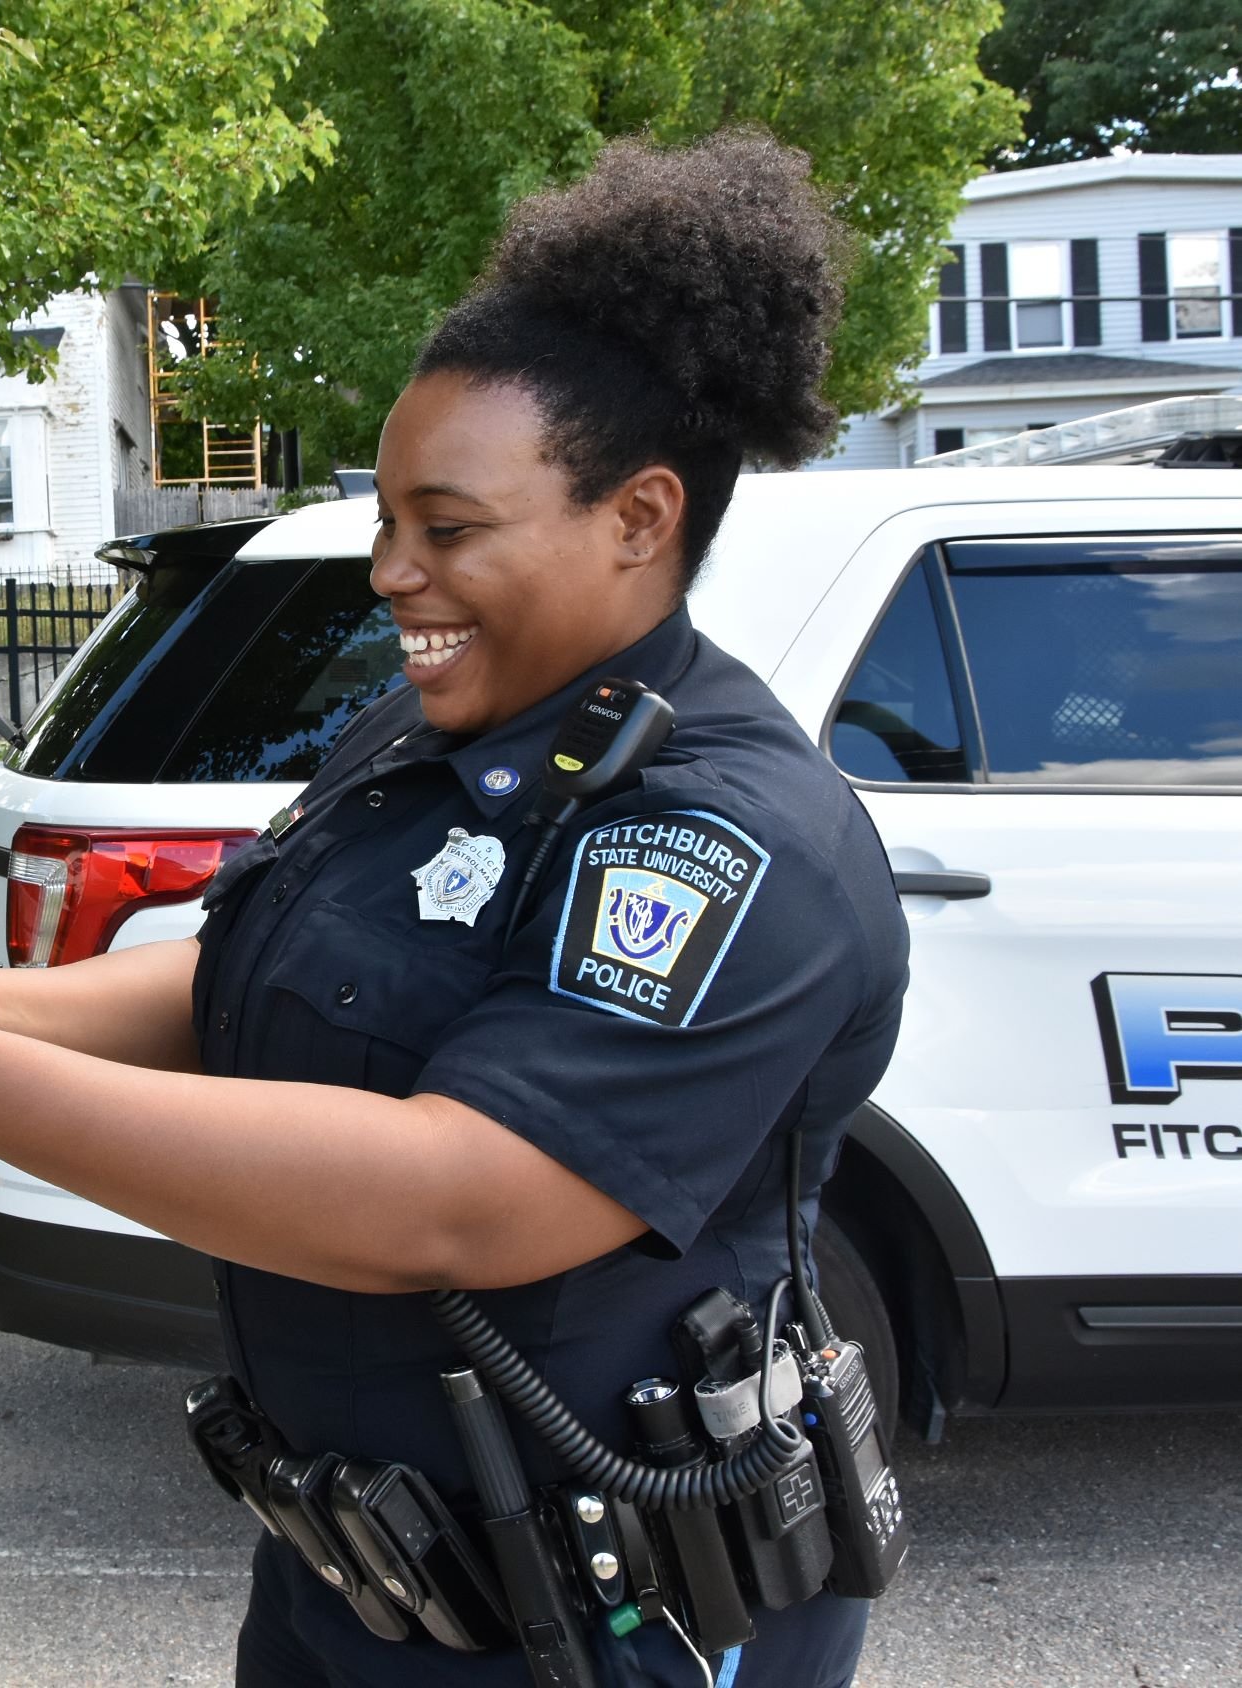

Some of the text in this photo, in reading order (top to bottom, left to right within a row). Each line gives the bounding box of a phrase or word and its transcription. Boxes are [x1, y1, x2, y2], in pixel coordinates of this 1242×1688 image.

[588, 704, 623, 721] KENWOOD
[450, 847, 495, 888] PATROLMAN
[461, 841, 500, 875] POLICE
[595, 824, 749, 882] FITCHBURG
[588, 848, 738, 905] STATE UNIVERSITY
[576, 957, 672, 1011] POLICE
[712, 1401, 751, 1424] TIME:
